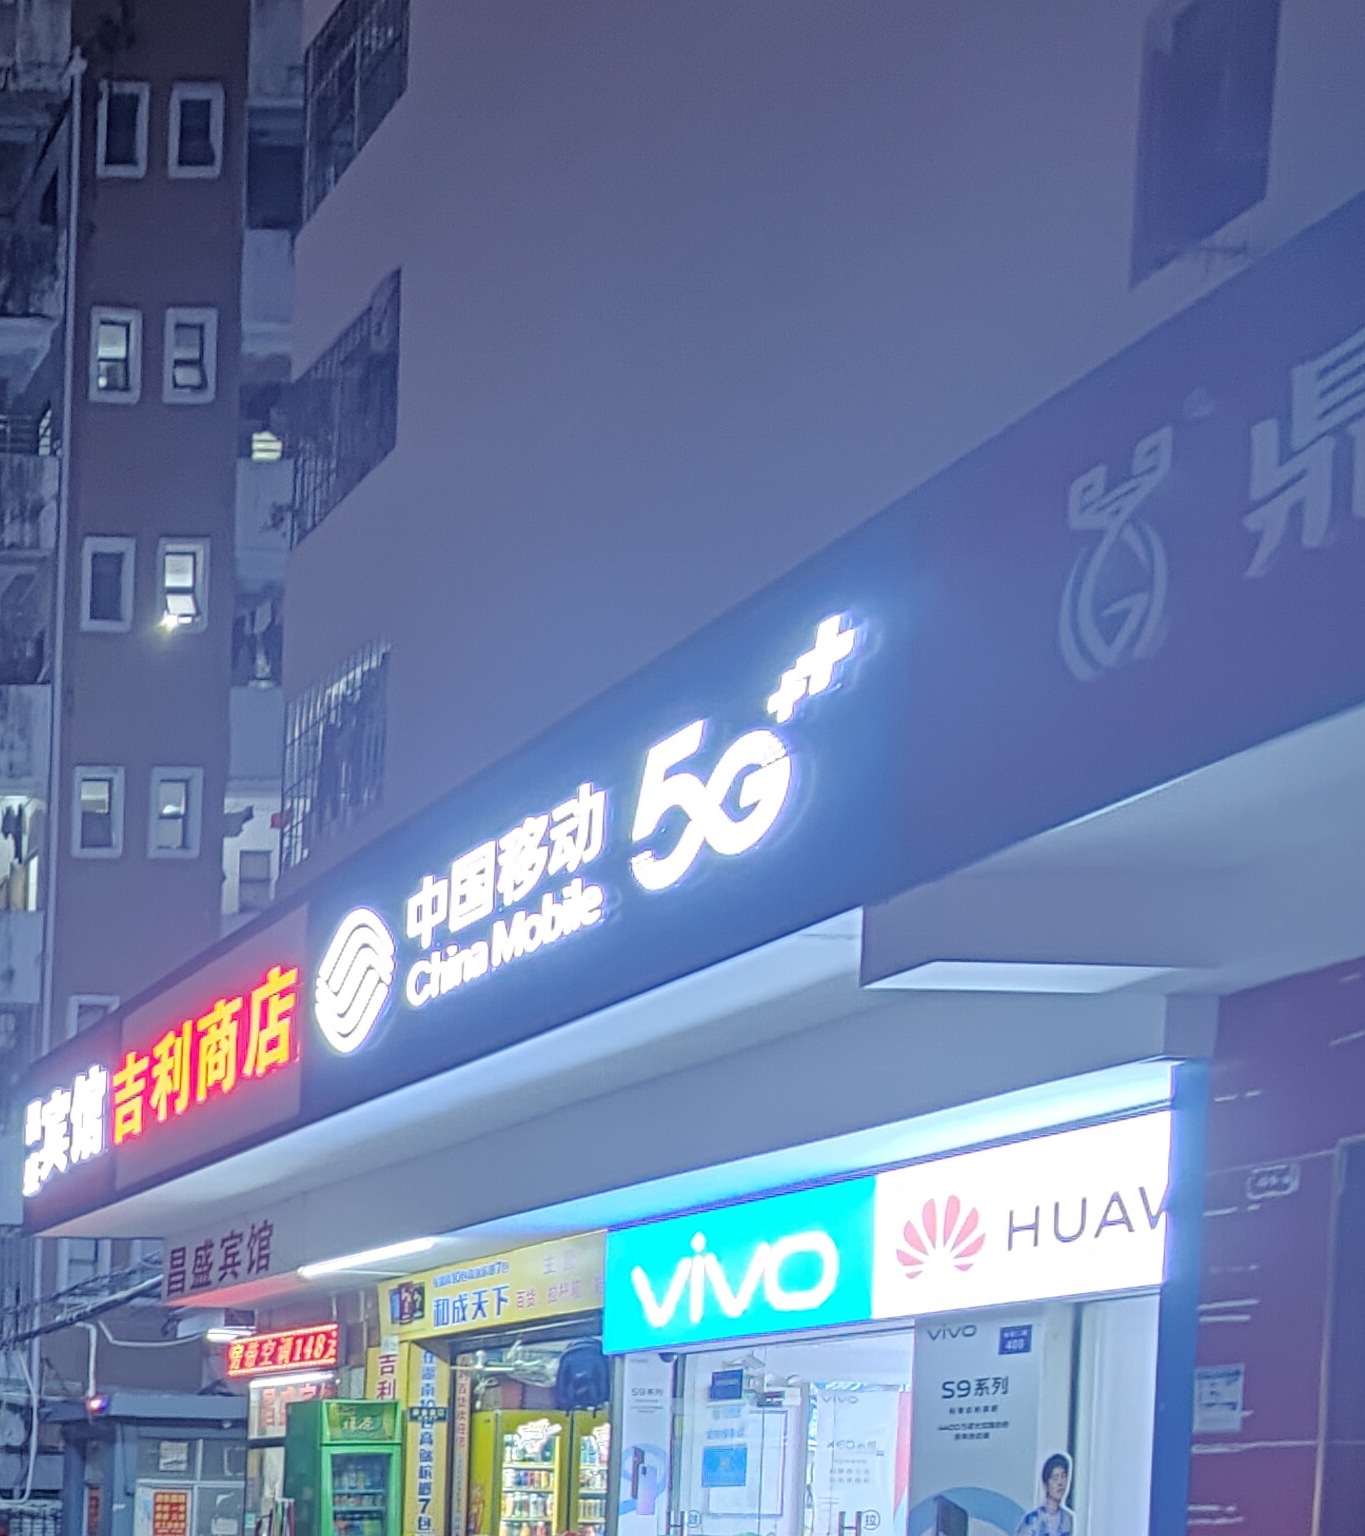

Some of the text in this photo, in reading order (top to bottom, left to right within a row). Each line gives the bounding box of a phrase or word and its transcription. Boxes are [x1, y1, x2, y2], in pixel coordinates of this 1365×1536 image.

[406, 782, 609, 949] 中国移动
[407, 876, 603, 1009] China Mobile
[112, 966, 302, 1146] 吉利商店
[167, 1218, 275, 1297] 昌盛宾馆
[432, 1285, 510, 1328] 和成天下
[941, 1375, 1009, 1400] S9系列
[865, 1514, 877, 1527] 拉
